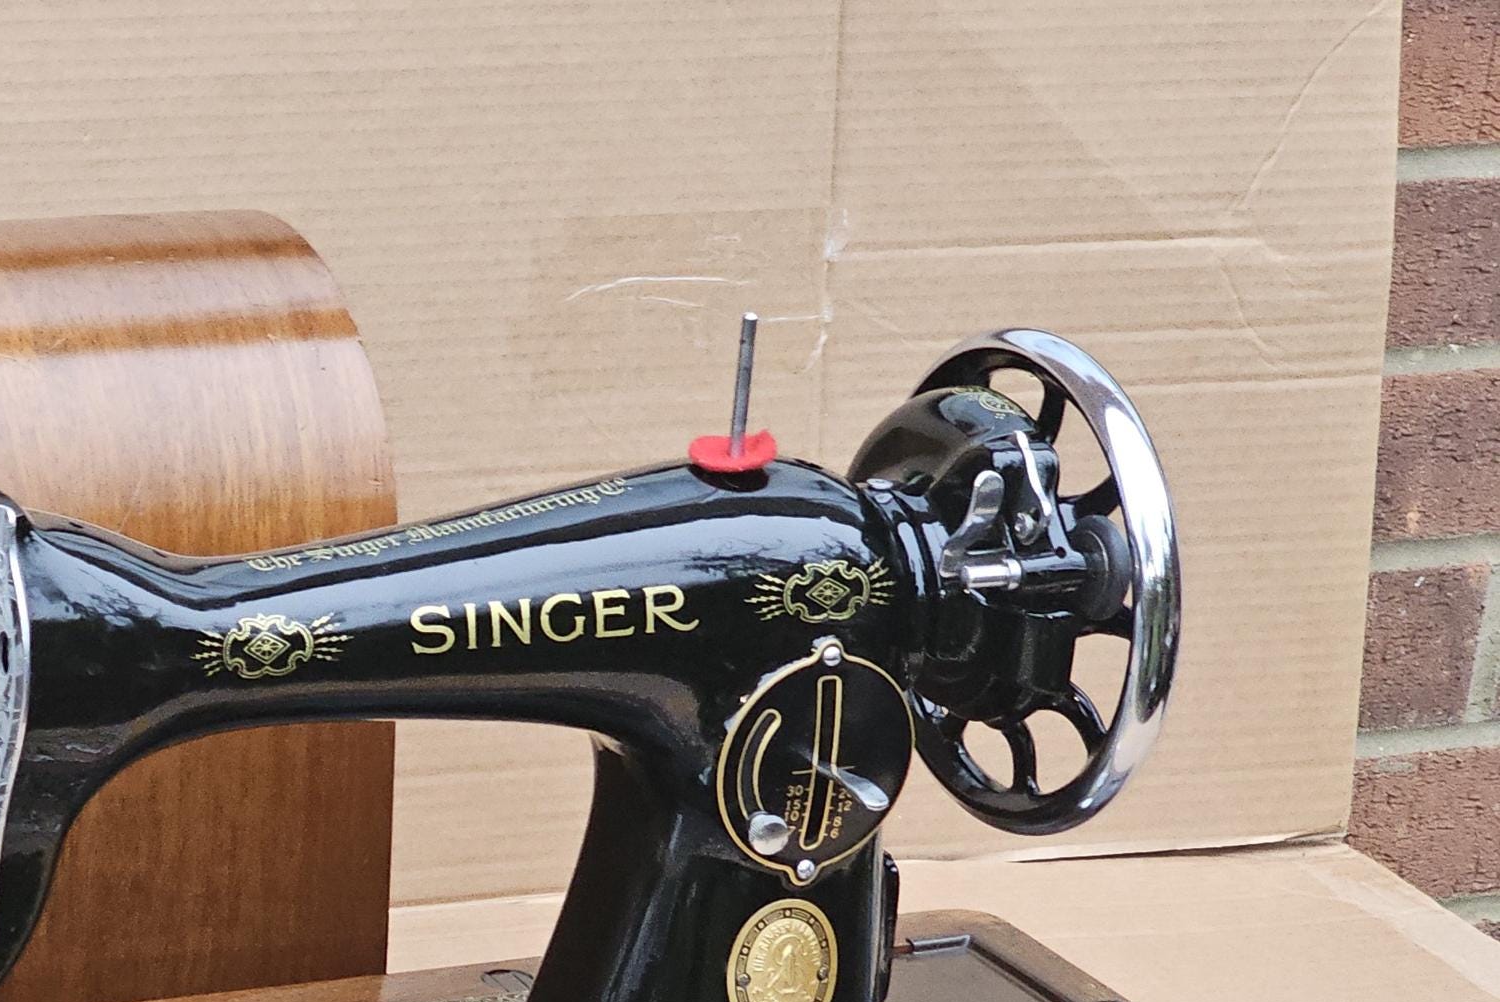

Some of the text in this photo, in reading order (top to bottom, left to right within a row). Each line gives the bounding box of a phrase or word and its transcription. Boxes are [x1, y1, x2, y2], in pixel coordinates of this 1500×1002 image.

[246, 555, 302, 571] The
[409, 584, 700, 655] SINGER
[786, 784, 804, 797] 30
[786, 800, 801, 811] 15
[837, 800, 852, 813] 12
[784, 811, 799, 822] 10
[830, 828, 839, 839] 6
